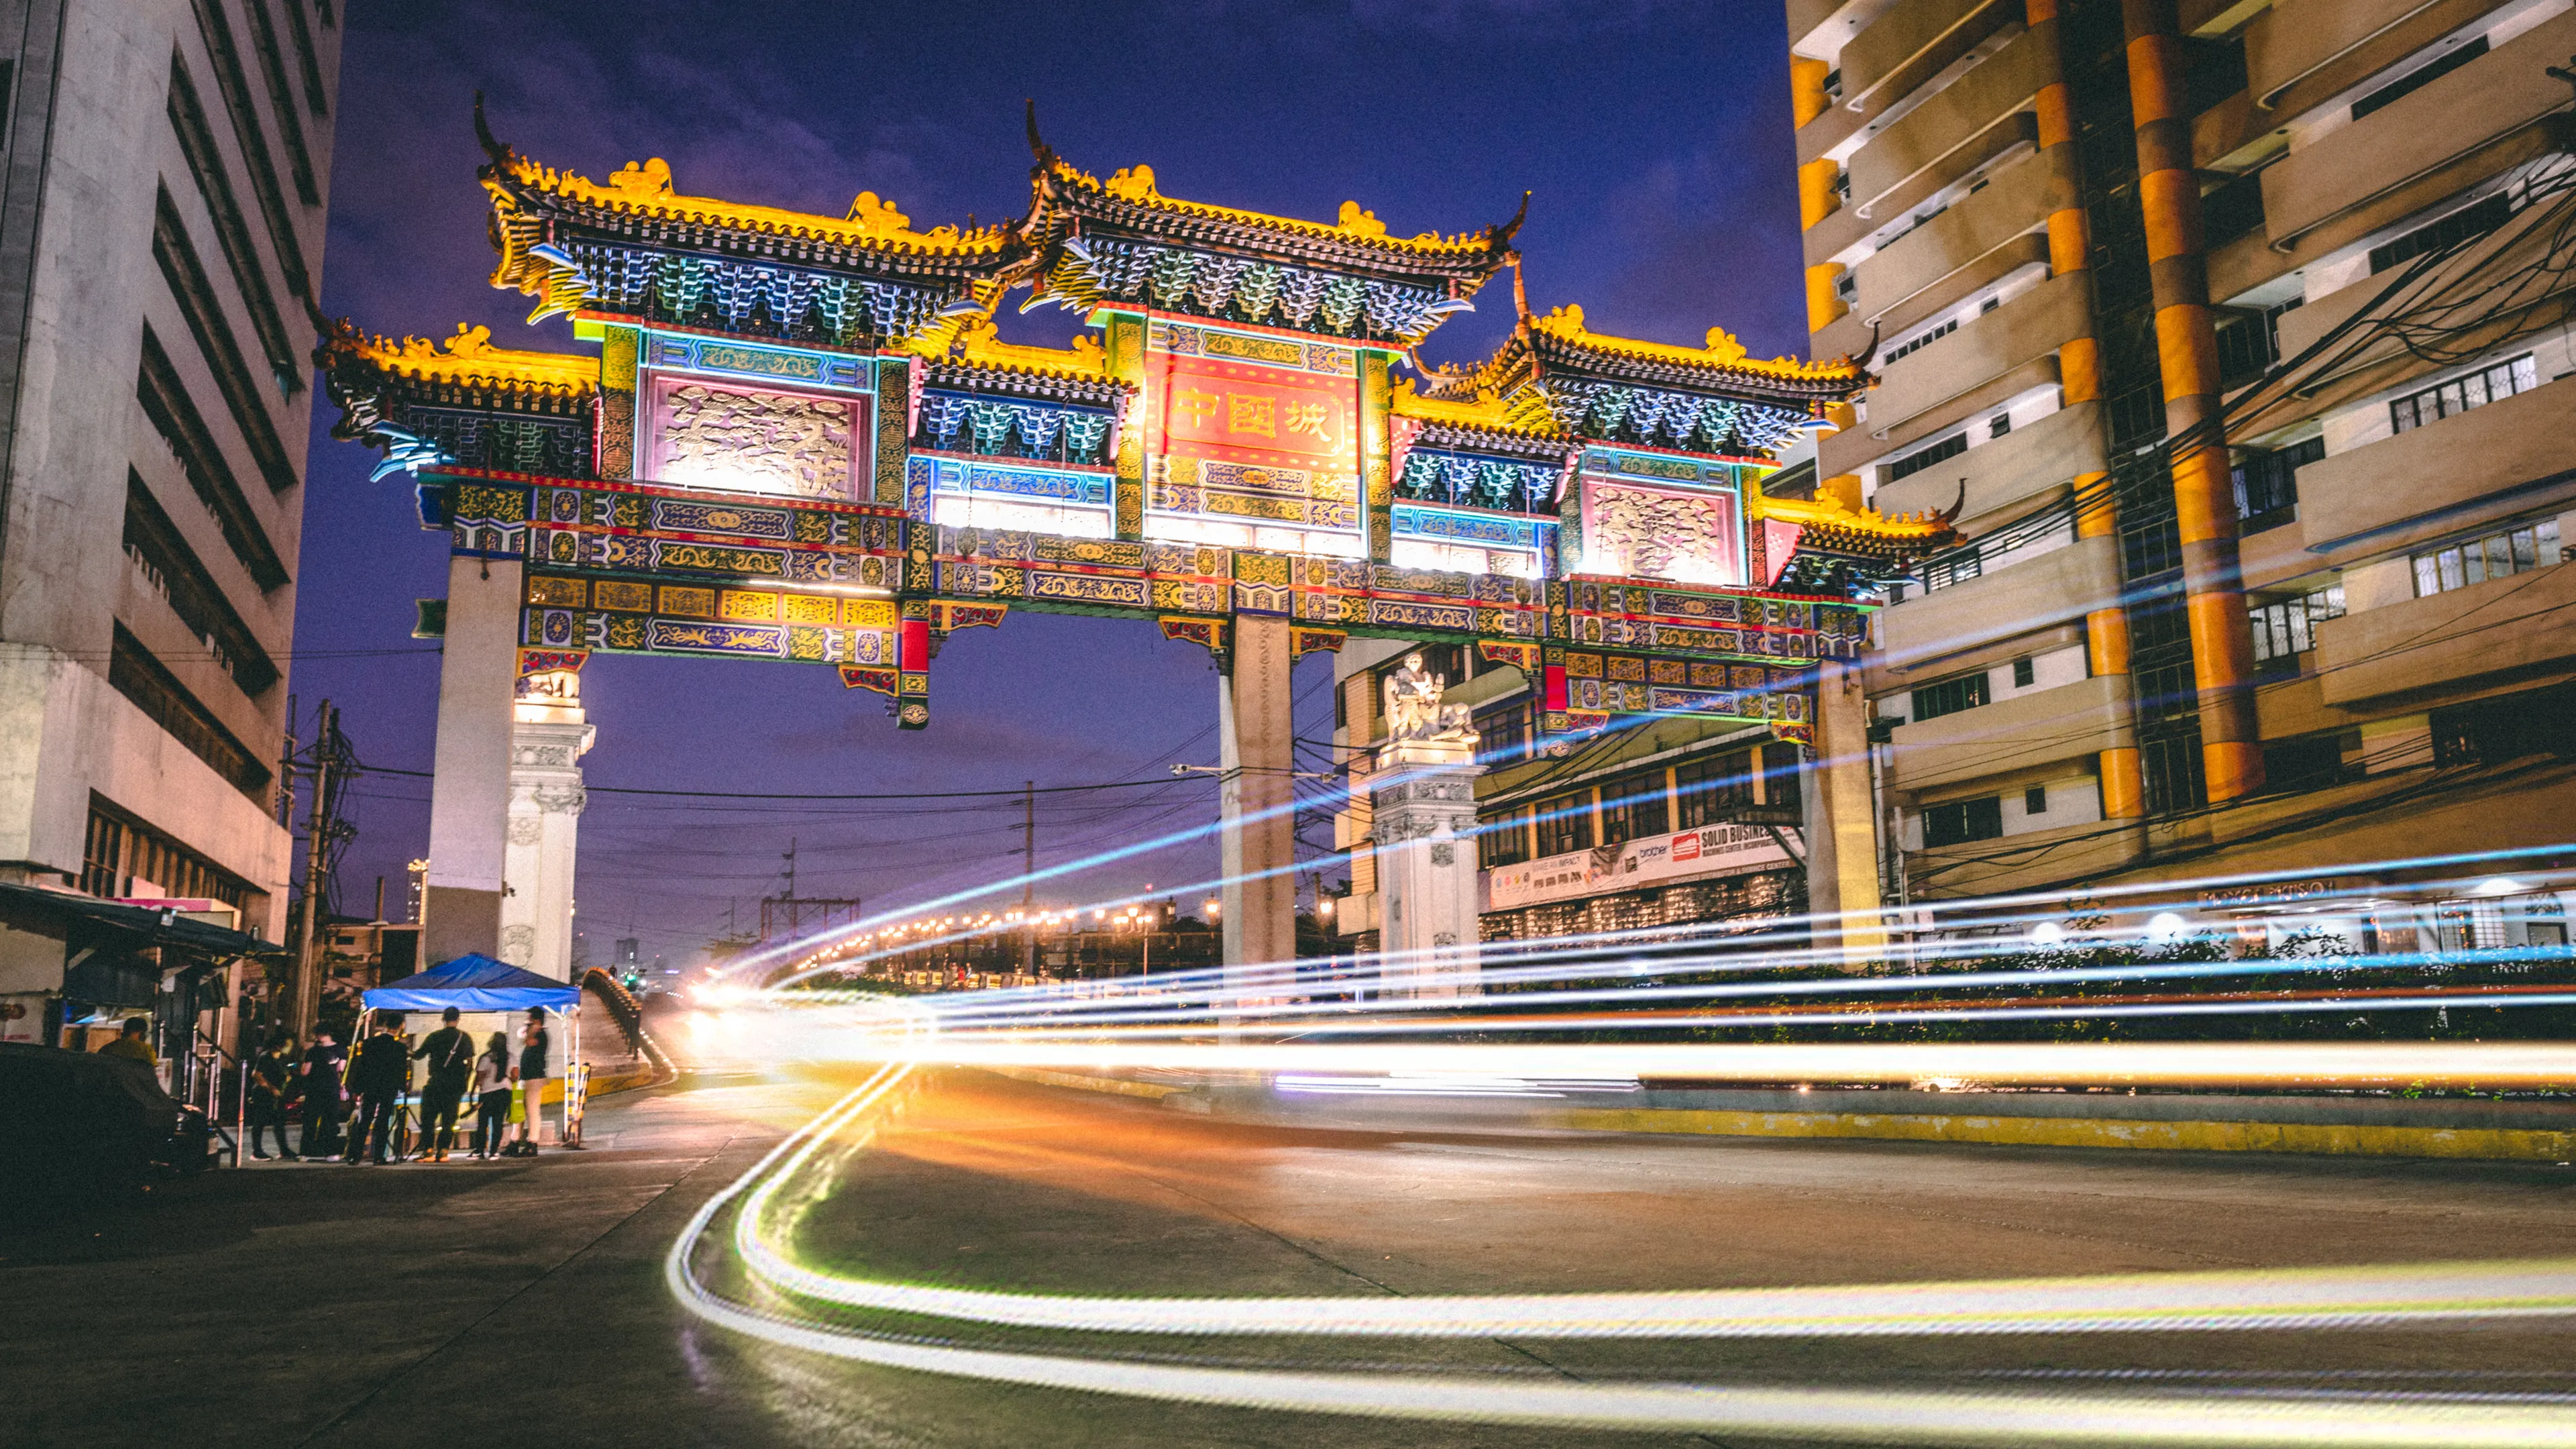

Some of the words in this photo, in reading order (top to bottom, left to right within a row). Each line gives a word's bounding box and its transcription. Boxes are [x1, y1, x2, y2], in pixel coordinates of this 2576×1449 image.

[1173, 388, 1333, 443] 中國城
[1702, 828, 1727, 848] SOLID
[1640, 845, 1667, 858] brother
[1559, 857, 1580, 867] IMPACT
[1741, 865, 1765, 873] SERVICE
[1766, 861, 1790, 870] CENTER
